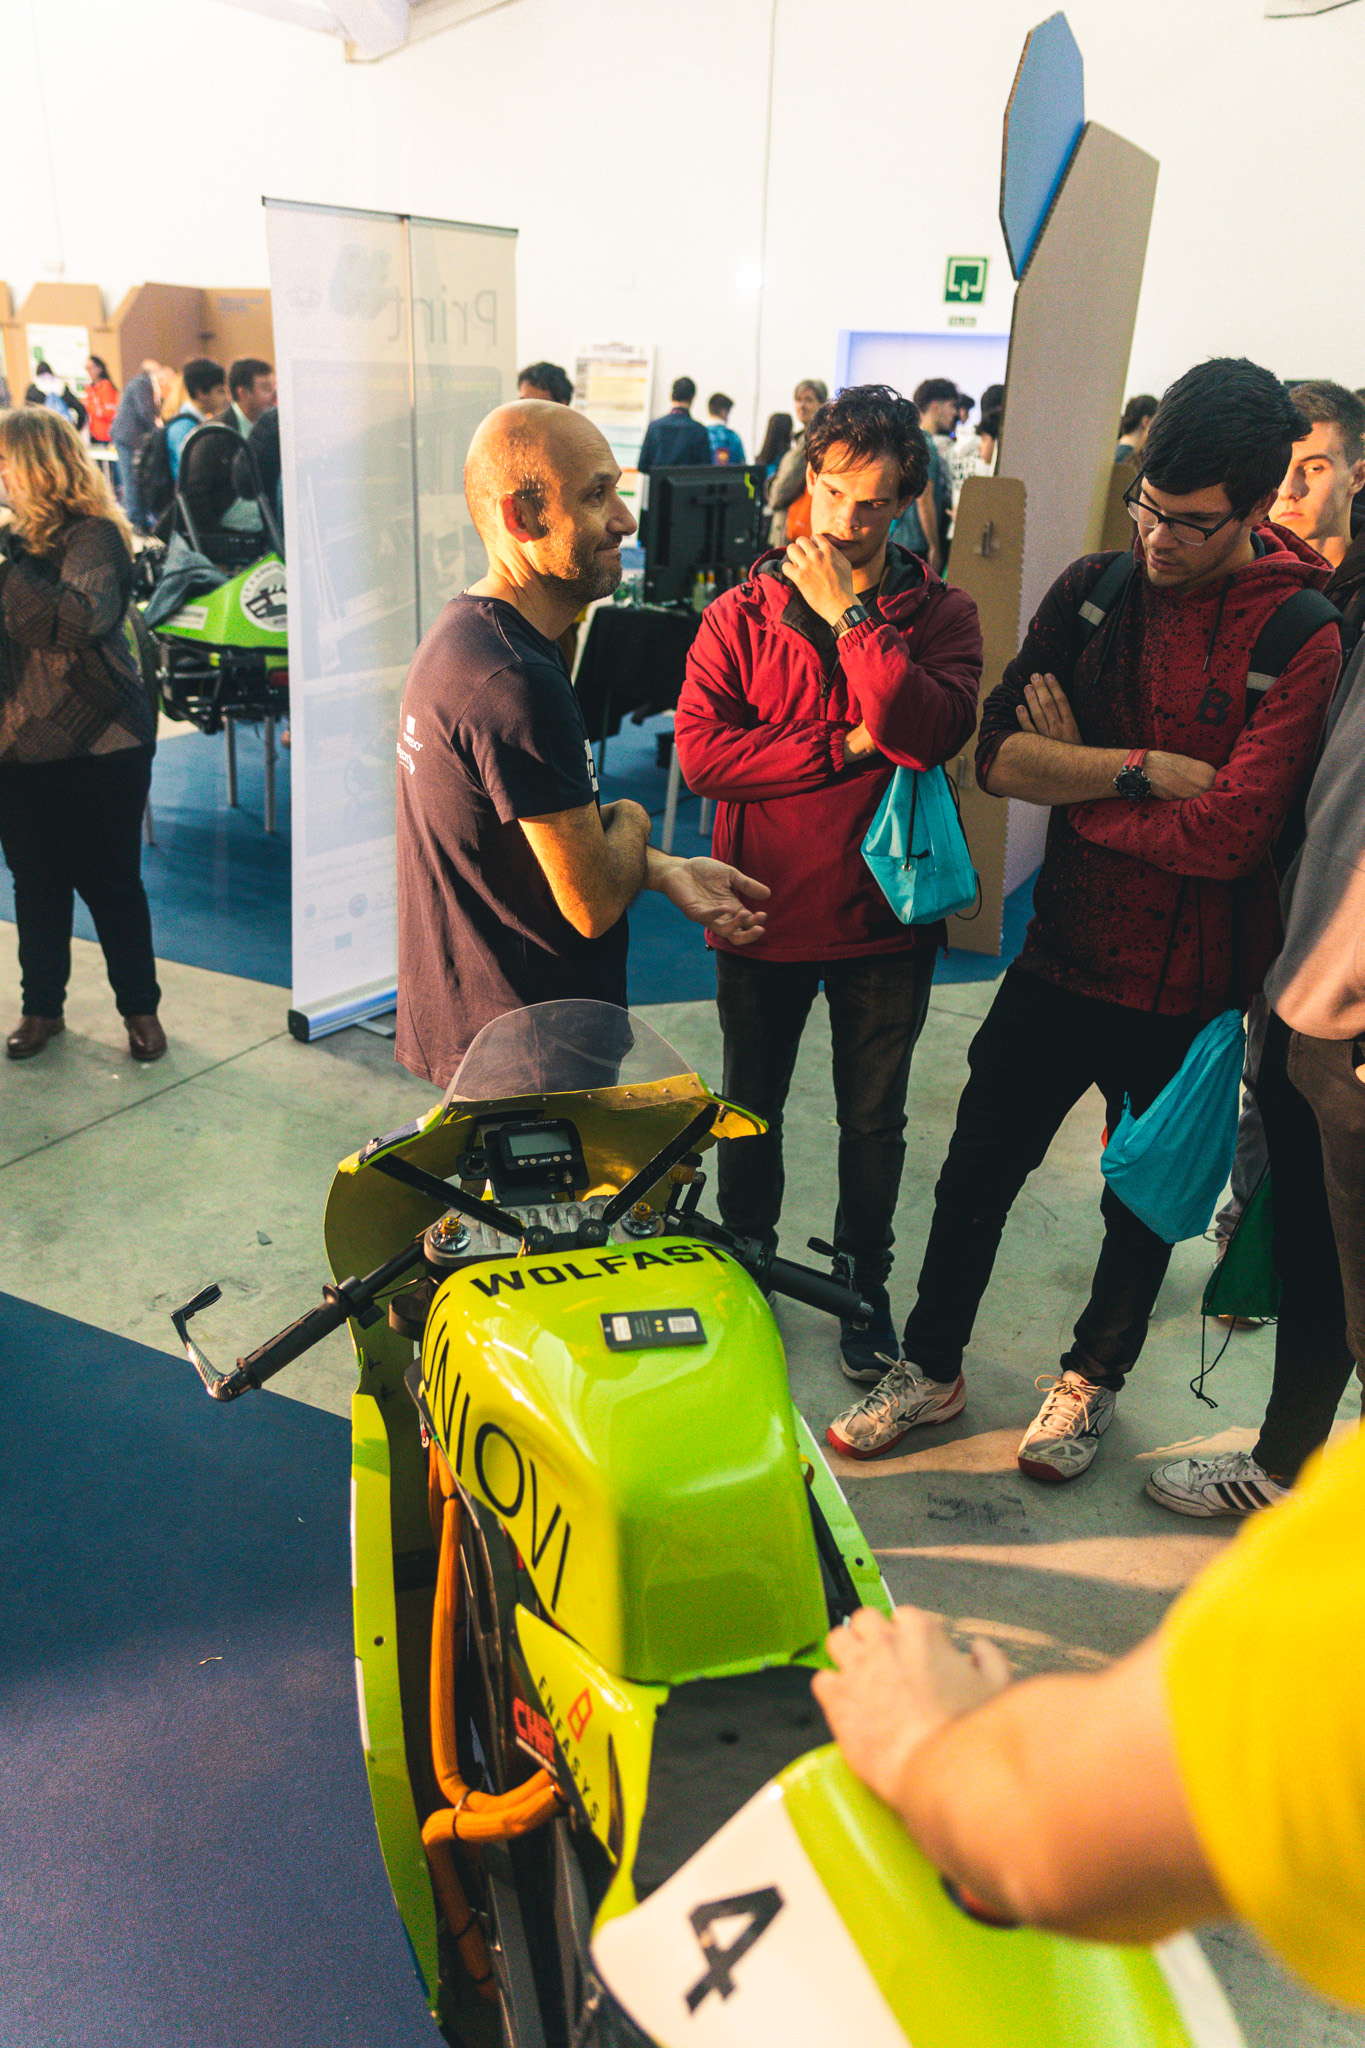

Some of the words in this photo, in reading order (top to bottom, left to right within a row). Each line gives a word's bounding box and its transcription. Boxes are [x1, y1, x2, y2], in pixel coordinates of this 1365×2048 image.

[470, 1244, 729, 1297] WOLFAST
[421, 1291, 571, 1614] UNIOVI
[539, 1675, 600, 1822] ENFASYS
[686, 1886, 785, 2016] 4
